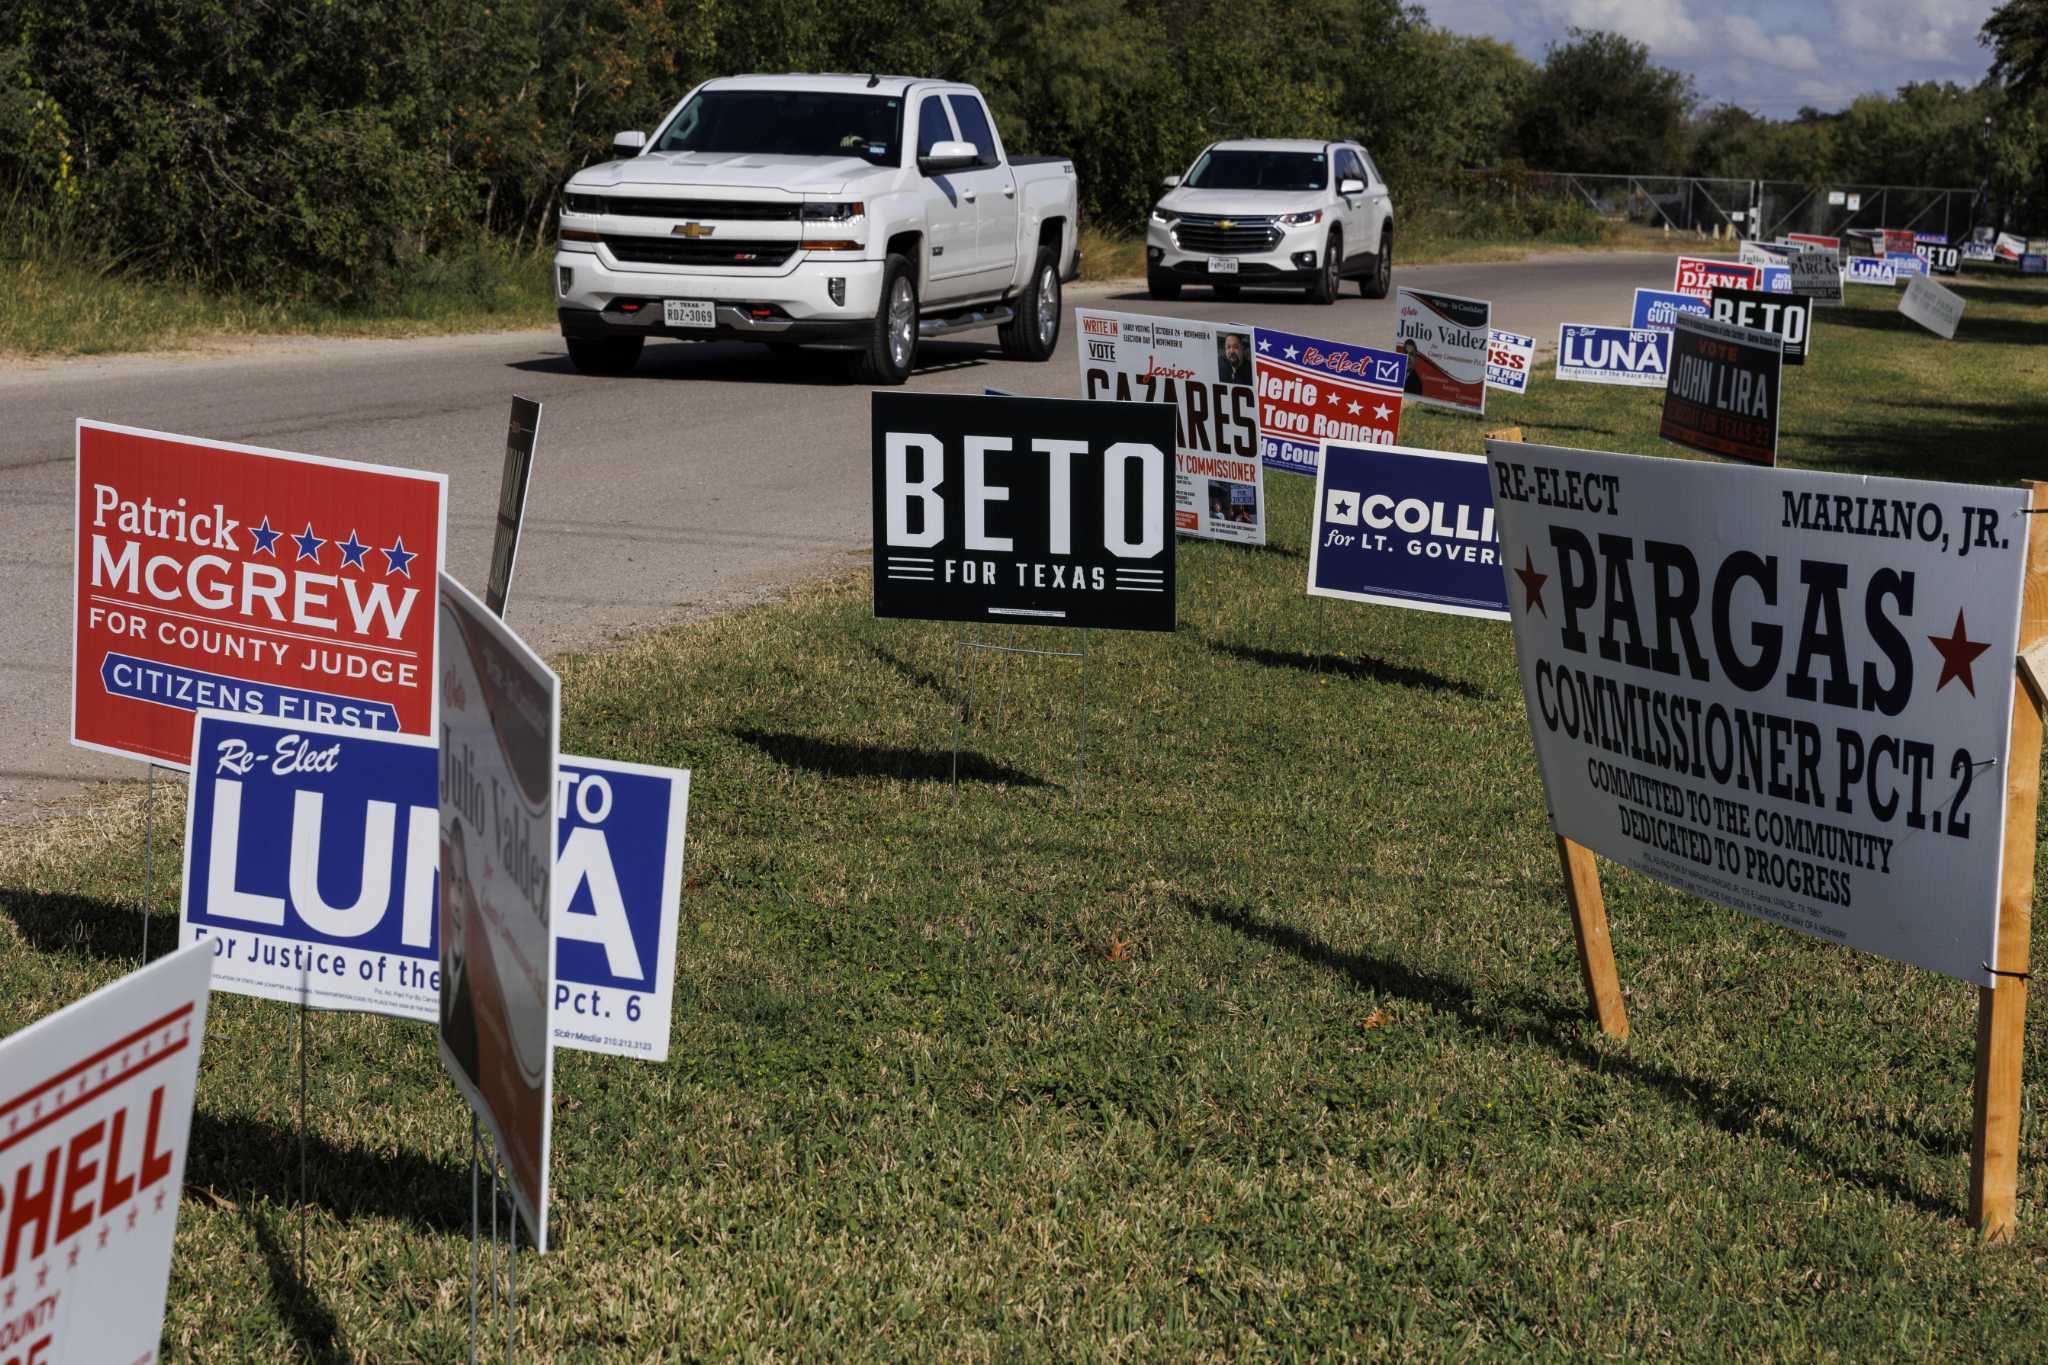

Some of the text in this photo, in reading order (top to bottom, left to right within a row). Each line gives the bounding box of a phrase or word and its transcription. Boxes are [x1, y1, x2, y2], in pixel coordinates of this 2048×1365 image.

[1792, 262, 1839, 275] PARGAS
[1850, 262, 1894, 280] LUNA
[1916, 245, 1958, 268] BETO
[1681, 271, 1749, 290] DIANA
[1083, 318, 1118, 336] WRITE IN
[1653, 301, 1706, 314] ROLAND
[1714, 297, 1806, 344] BETO
[1088, 342, 1116, 360] VOTE
[1155, 326, 1173, 336] OCTOBER
[1156, 338, 1178, 348] NOVEMBER
[1397, 319, 1432, 341] Julio
[1438, 326, 1487, 351] Valdez
[1630, 331, 1657, 343] NETO
[1697, 340, 1738, 362] VOTE
[1143, 354, 1197, 384] Javier
[1303, 346, 1373, 377] Re-Elect
[1563, 336, 1664, 373] LUNA
[1257, 371, 1318, 406] lerie
[1672, 353, 1768, 419] JOHN LIRA
[1263, 403, 1394, 446] Toro Romero
[1186, 453, 1256, 483] COMMISSIONER
[1495, 461, 1619, 516] RE-ELECT
[885, 431, 1164, 560] BETO
[93, 483, 240, 552] Patrick
[1362, 494, 1500, 544] COLLI
[1781, 490, 2009, 557] MARIANO, JR.
[1324, 528, 1503, 566] for LT. GOVER
[945, 559, 1106, 591] FOR TEXAS
[1549, 524, 1915, 717] PARGAS
[89, 607, 419, 689] FOR COUNTY JUDGE
[112, 661, 386, 731] CITIZENS FIRST
[1536, 657, 1824, 808] COMMISSIONER
[216, 733, 341, 777] Re-Elect
[556, 771, 613, 825] TO
[1587, 756, 1894, 875] COMMITTED TO THE COMMUNITY
[439, 721, 486, 837] Julio
[491, 775, 549, 930] Valdez
[1618, 803, 1712, 868] DEDICATED
[1713, 835, 1740, 875] TO
[1744, 845, 1852, 908] PROGRESS
[247, 936, 347, 977] Justice
[359, 955, 387, 983] of
[398, 960, 441, 992] the
[555, 983, 641, 1022] Pct. 6
[0, 1084, 173, 1280] HELL
[0, 1290, 61, 1351] OUNTY
